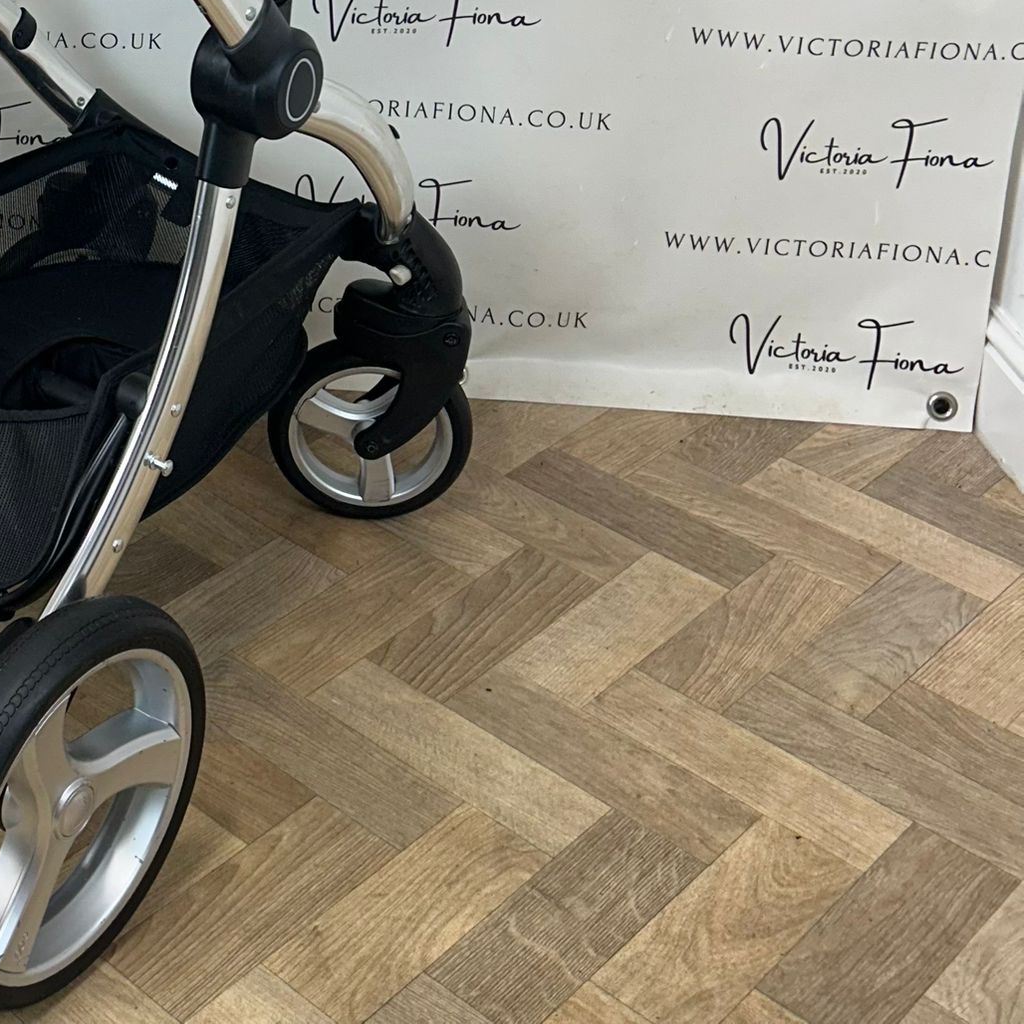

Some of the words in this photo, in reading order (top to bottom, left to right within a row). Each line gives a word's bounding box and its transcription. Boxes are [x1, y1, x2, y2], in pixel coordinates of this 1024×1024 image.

[759, 116, 889, 181] Victoria
[889, 117, 995, 190] Fiona
[728, 312, 857, 376] Victoria
[856, 318, 965, 391] Fiona
